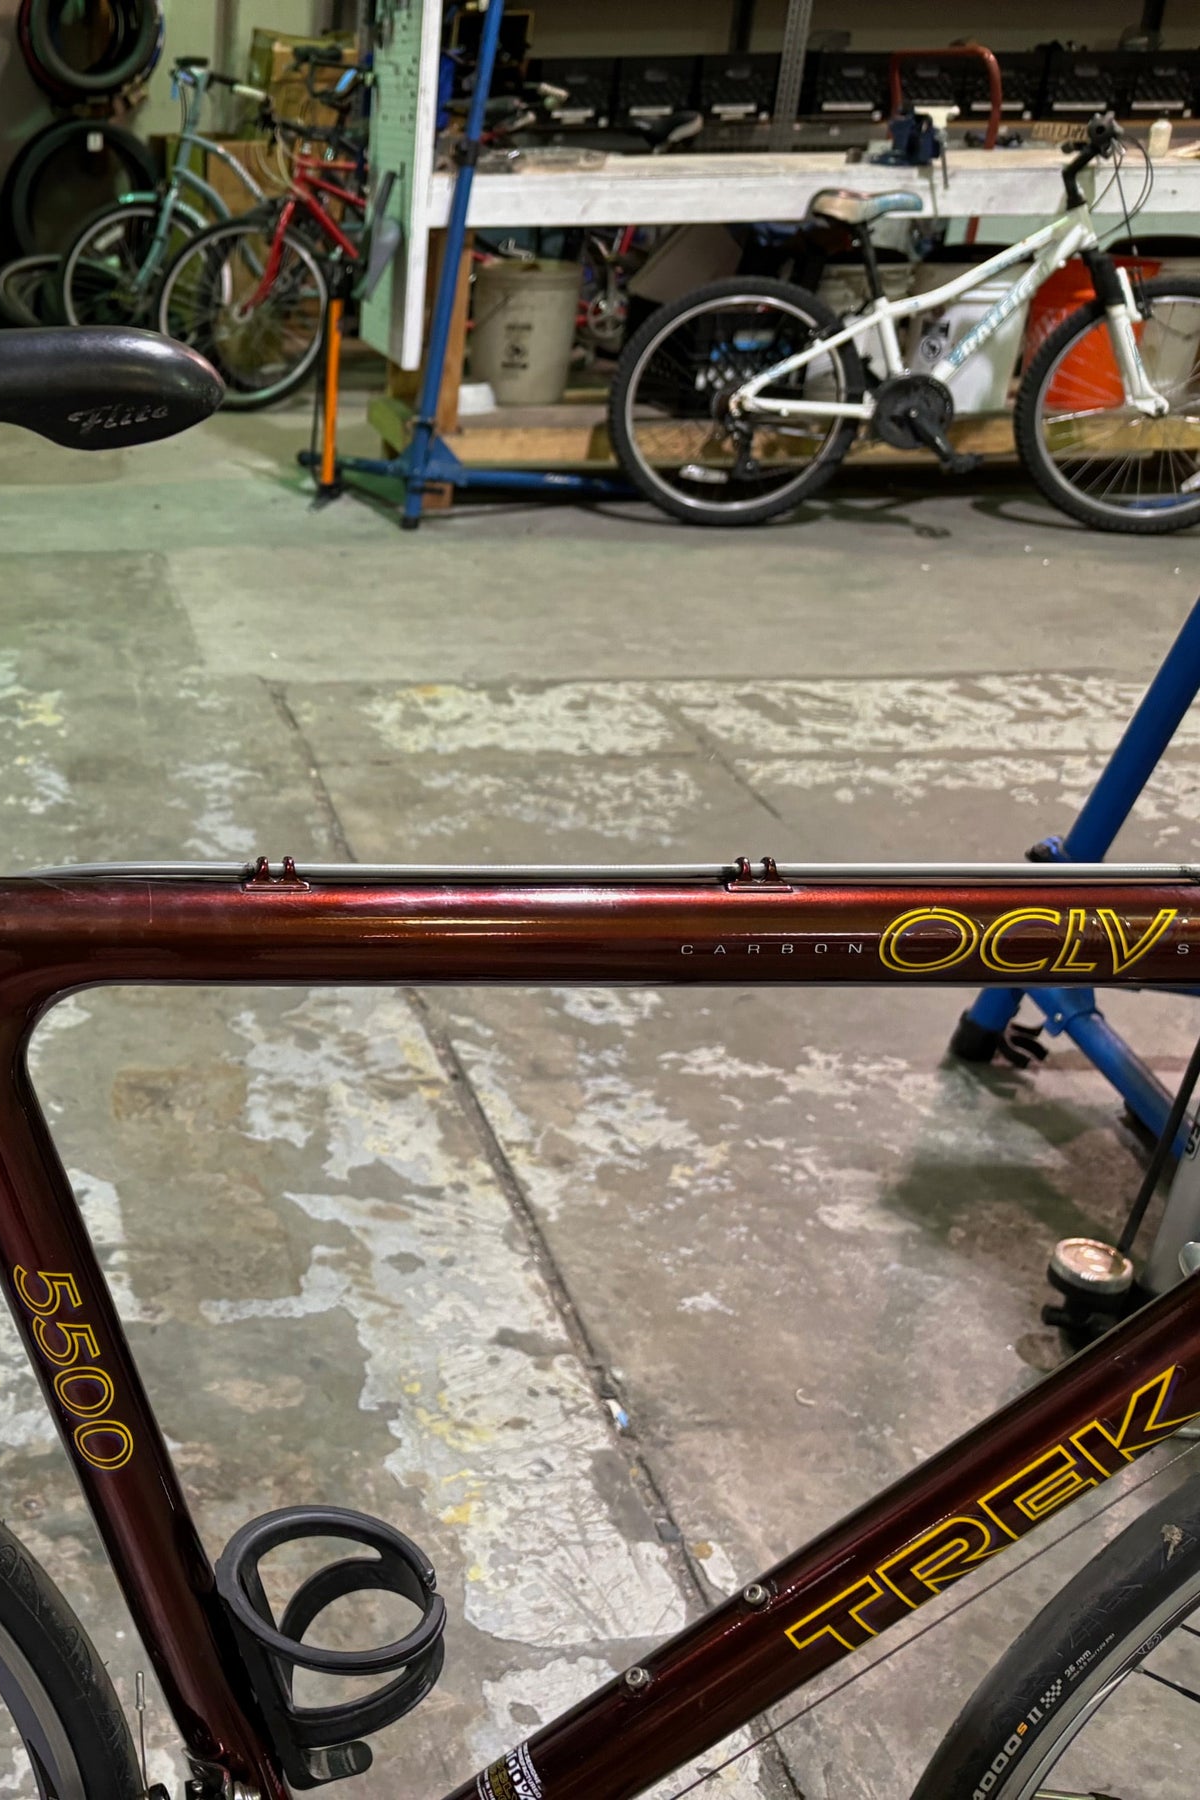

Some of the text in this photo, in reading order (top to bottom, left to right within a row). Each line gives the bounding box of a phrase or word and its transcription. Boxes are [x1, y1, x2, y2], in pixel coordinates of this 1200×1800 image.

[680, 942, 864, 955] CARBON
[878, 907, 1179, 975] OCLV
[13, 1264, 134, 1471] 5500
[784, 1363, 1200, 1652] TREK
